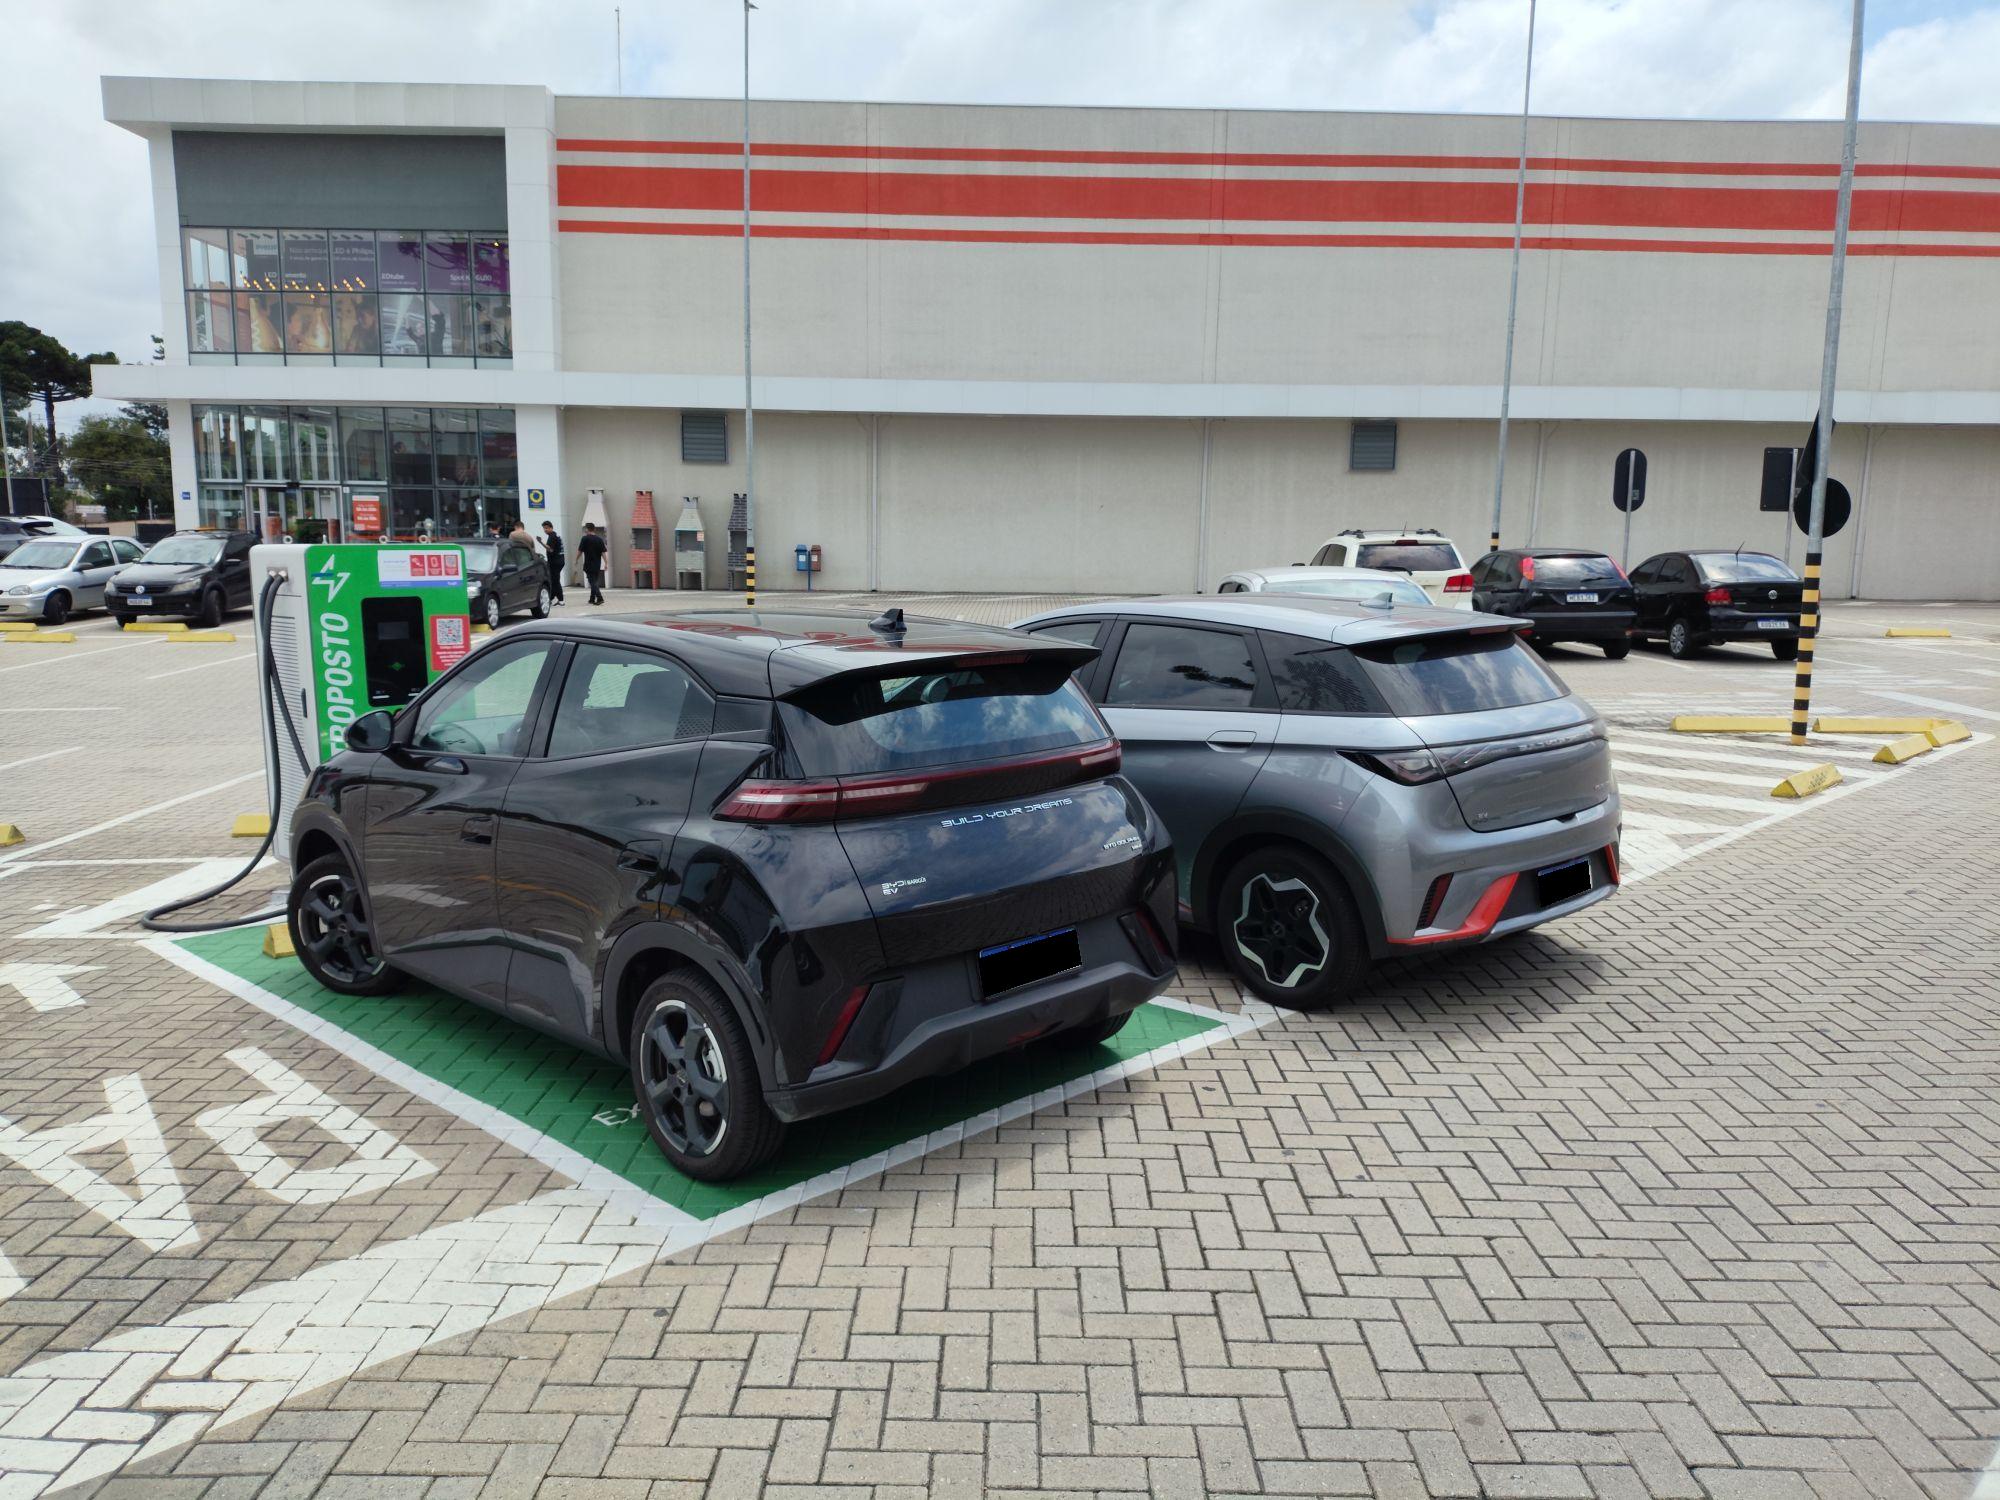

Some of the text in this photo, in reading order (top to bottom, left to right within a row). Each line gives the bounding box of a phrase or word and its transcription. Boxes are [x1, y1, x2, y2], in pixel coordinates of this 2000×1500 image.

[941, 798, 1073, 828] BUILD YOUR DREAMS
[883, 888, 898, 896] EV
